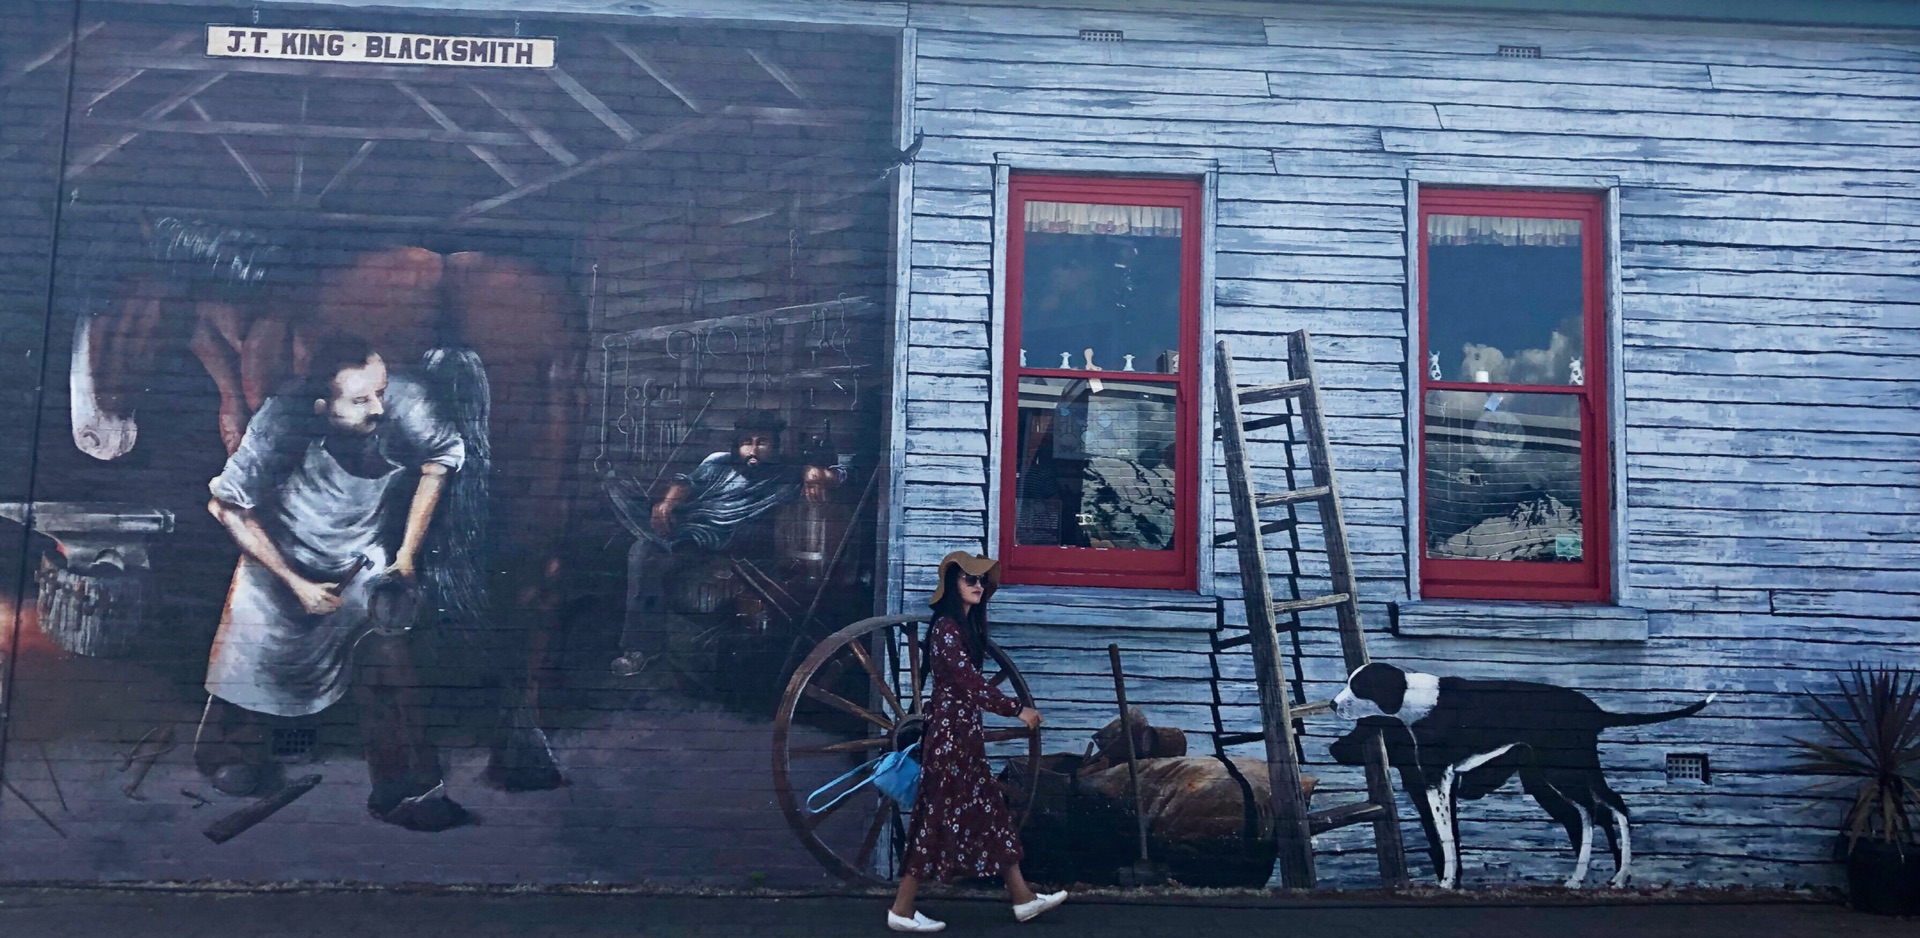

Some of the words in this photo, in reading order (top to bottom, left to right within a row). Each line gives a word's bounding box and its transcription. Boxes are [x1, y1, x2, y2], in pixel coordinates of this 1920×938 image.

[227, 30, 269, 53] J.T.
[280, 32, 344, 56] KING
[365, 36, 533, 65] BLACKSMITH
